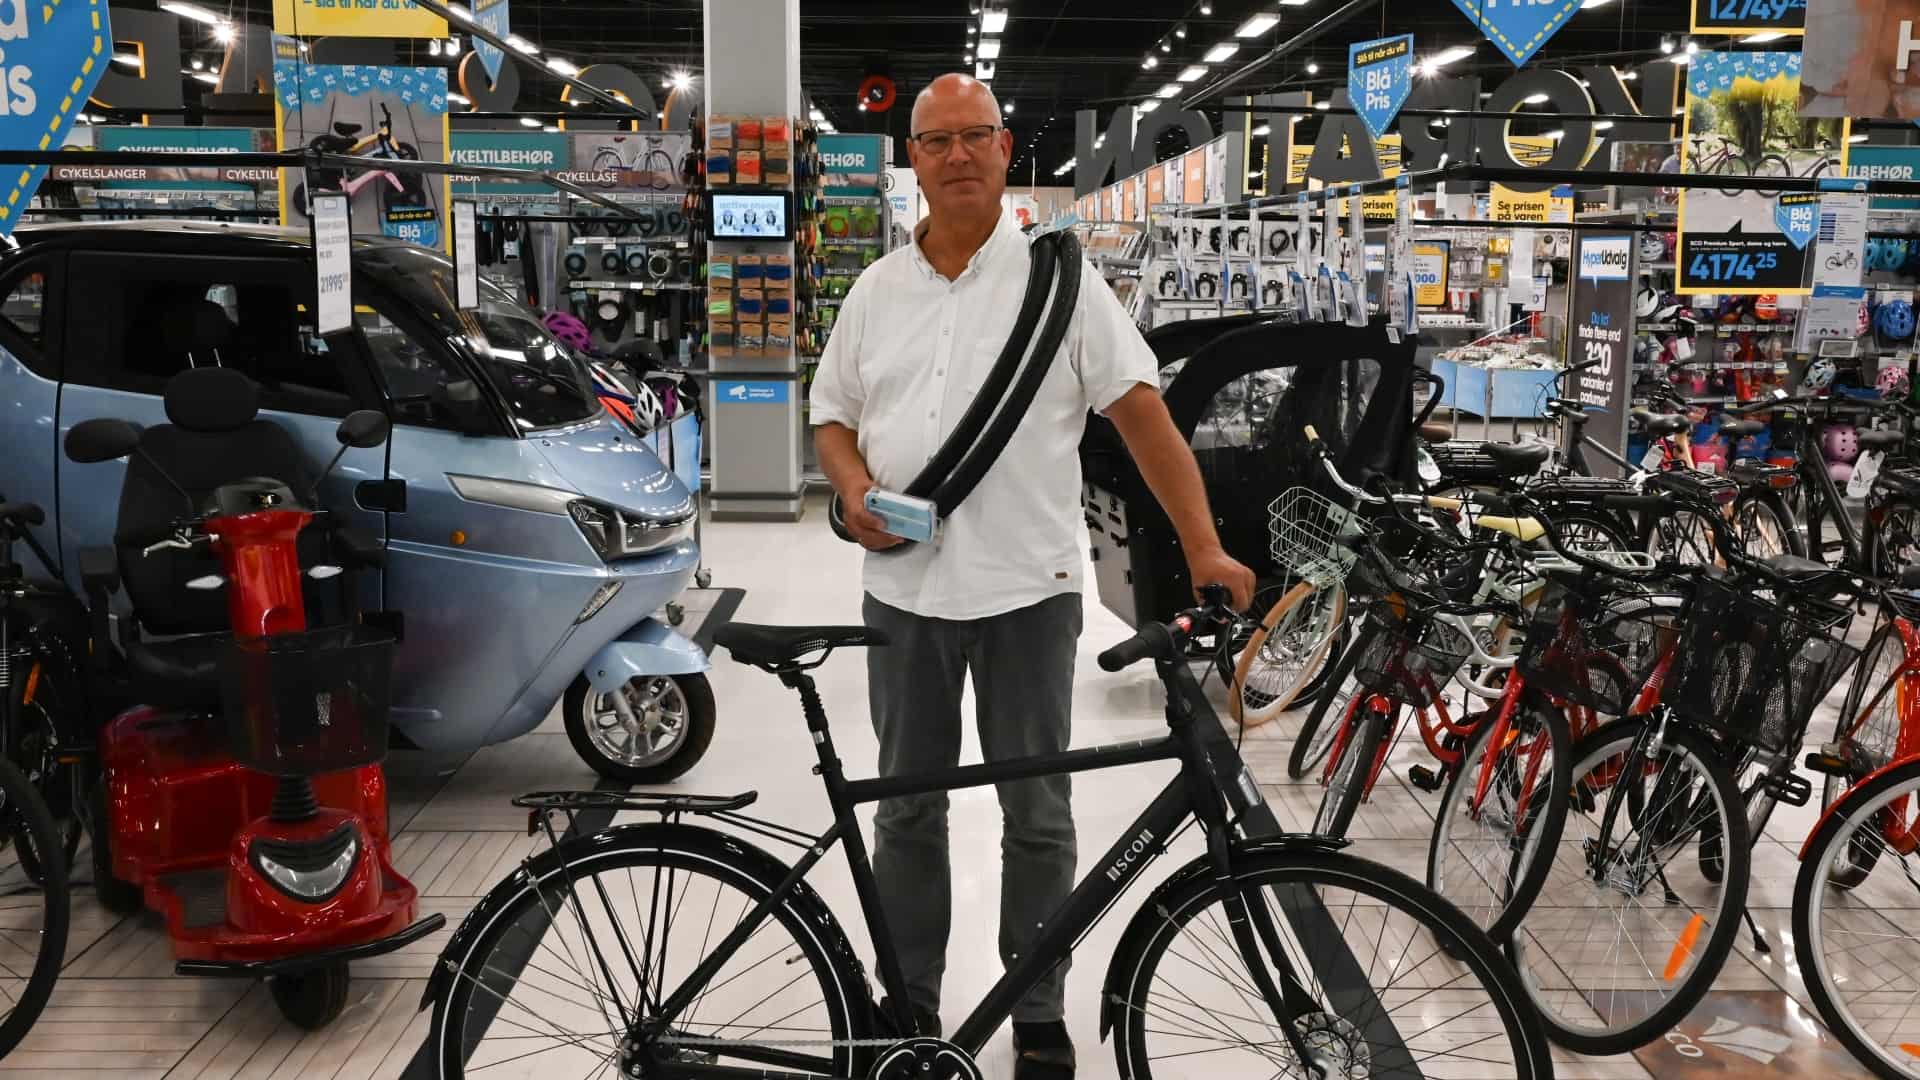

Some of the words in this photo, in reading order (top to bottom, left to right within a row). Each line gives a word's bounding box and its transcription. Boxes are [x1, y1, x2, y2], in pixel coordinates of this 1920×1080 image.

[1366, 66, 1391, 91] Blå
[1365, 90, 1391, 111] Pris
[60, 169, 147, 180] CYKELSLANGER
[1497, 200, 1511, 211] Se
[1513, 200, 1545, 213] prisen
[1514, 212, 1544, 221] varen
[1791, 207, 1812, 221] Blå
[399, 223, 421, 239] Blå
[1791, 220, 1811, 232] Pris
[1689, 254, 1757, 280] 4174
[1756, 252, 1777, 269] 25
[1608, 327, 1622, 342] end
